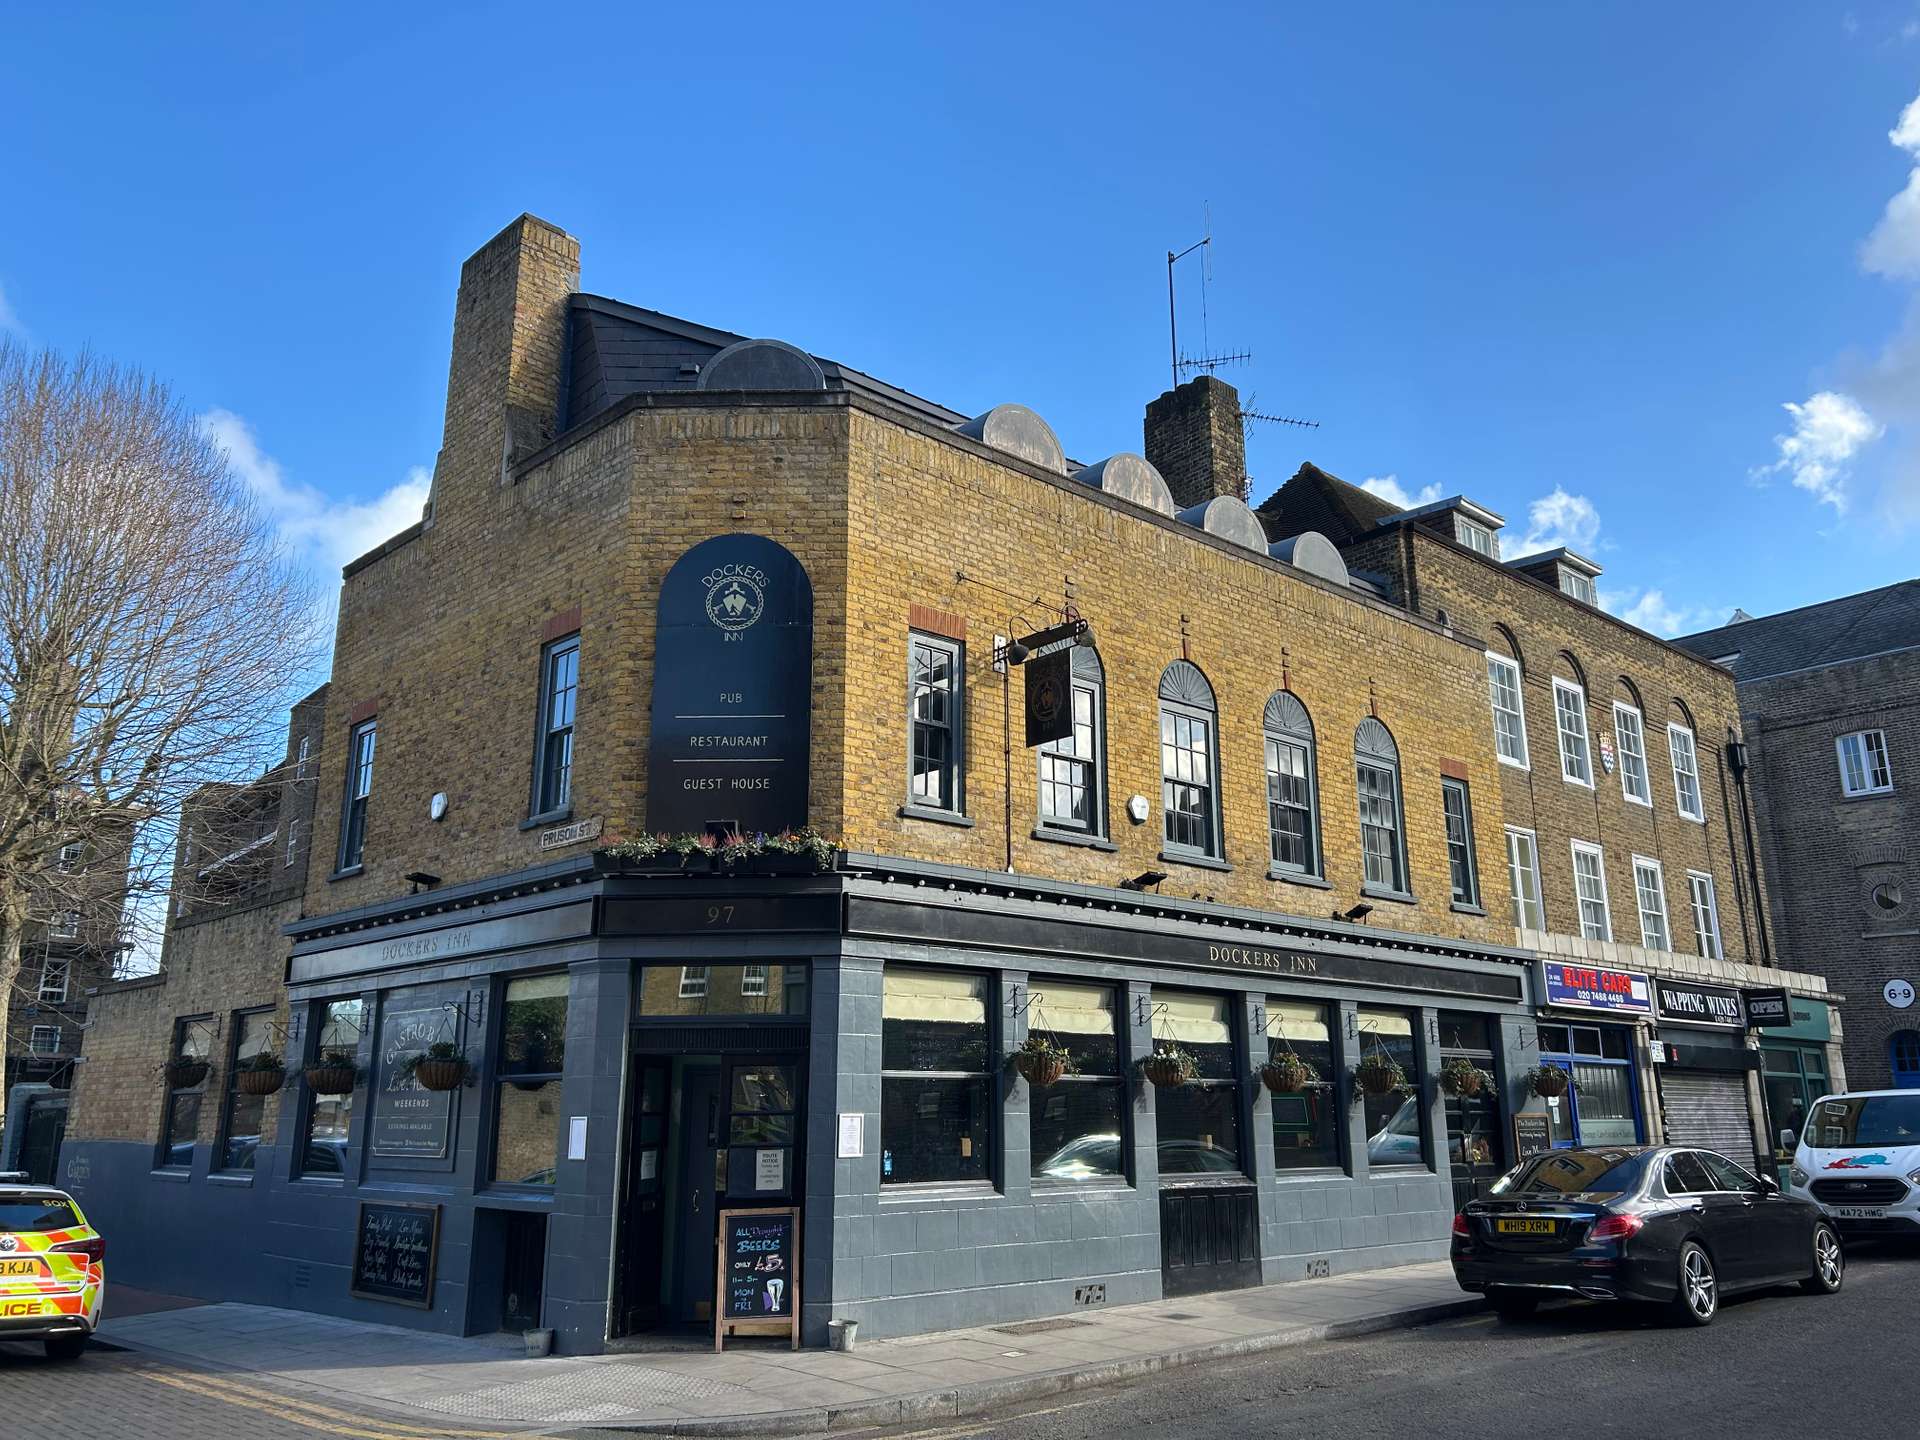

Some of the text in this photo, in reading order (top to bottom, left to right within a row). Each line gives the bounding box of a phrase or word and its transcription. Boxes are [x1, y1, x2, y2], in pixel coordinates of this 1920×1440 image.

[701, 564, 770, 588] DOCKERS
[724, 632, 743, 641] INN
[720, 693, 743, 703] PUB
[690, 736, 768, 746] RESTAURANT
[684, 778, 770, 789] GUEST HOUSE
[707, 906, 735, 923] 97
[382, 931, 472, 960] DOCKERS INN
[1209, 945, 1317, 971] DOCKERS INN
[1562, 966, 1632, 993] ELITE CARS
[1662, 990, 1738, 1016] WAPPING WINES
[1750, 1001, 1784, 1013] OPEN
[394, 1099, 430, 1108] WEEKENDS
[736, 1227, 750, 1237] ALL
[737, 1239, 780, 1253] BEERS
[8, 1262, 33, 1273] KJA
[734, 1261, 751, 1269] ONLY
[734, 1288, 754, 1297] MON
[0, 1303, 41, 1316] ICE
[734, 1301, 752, 1310] FRI
